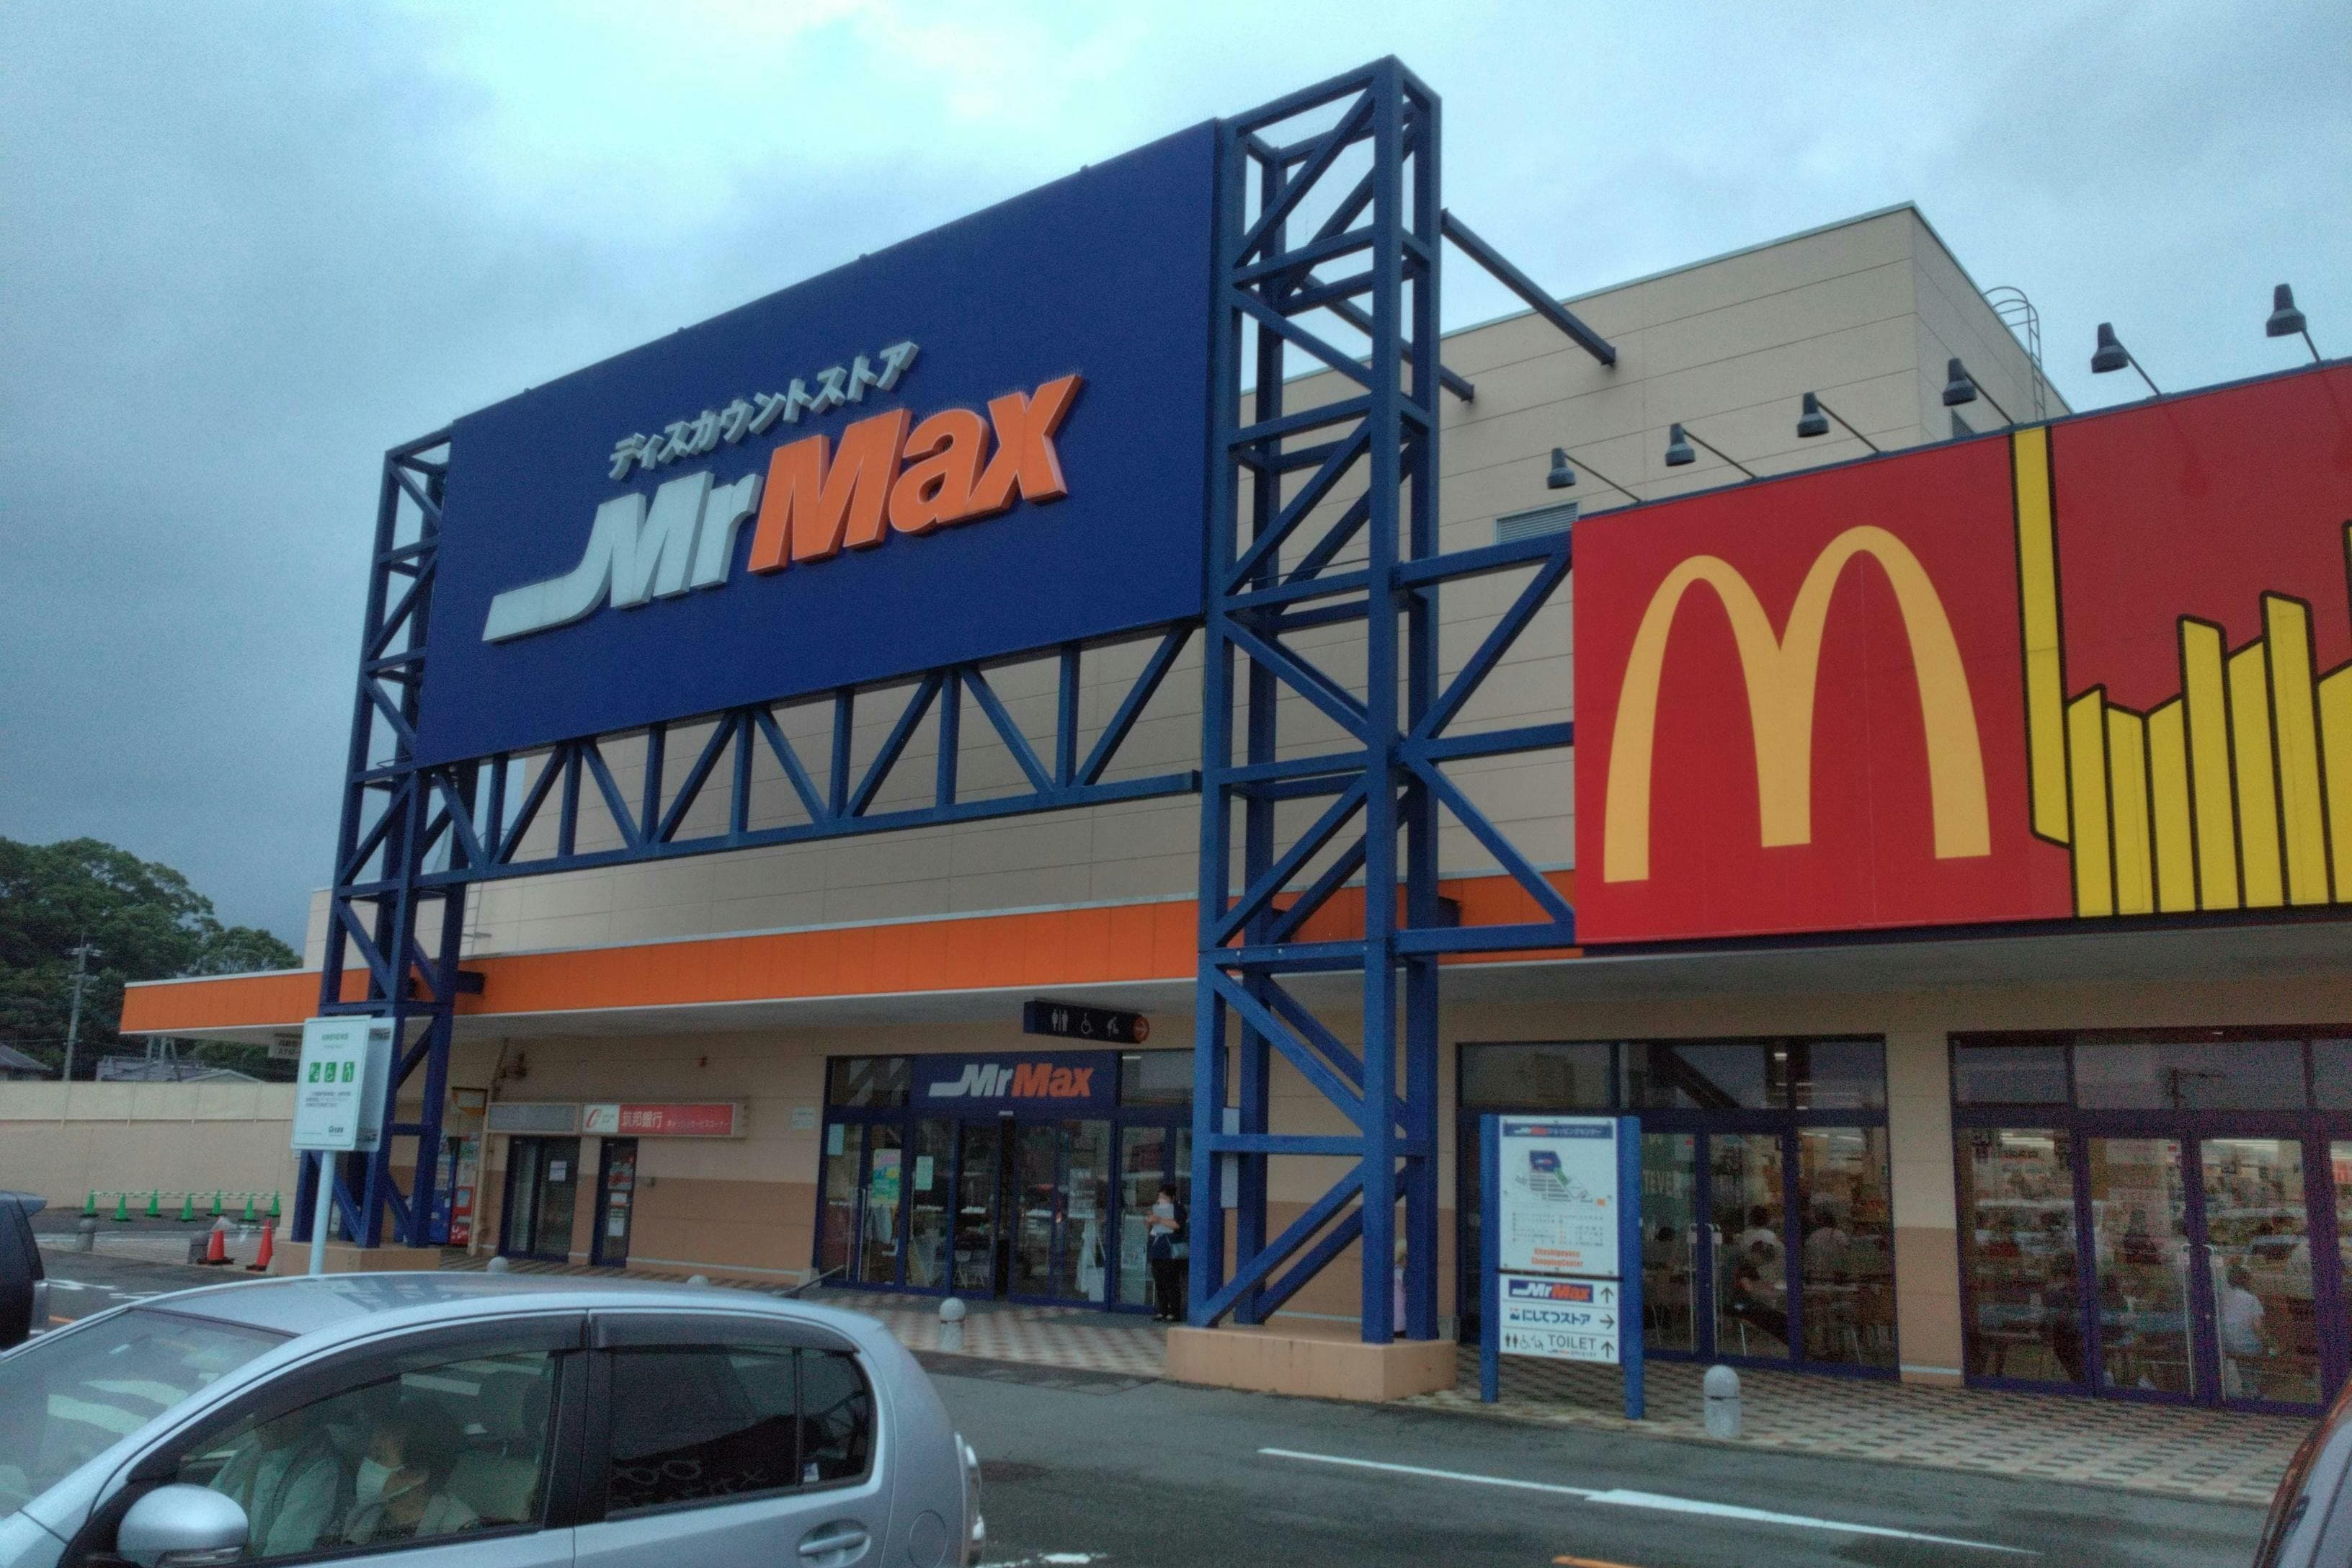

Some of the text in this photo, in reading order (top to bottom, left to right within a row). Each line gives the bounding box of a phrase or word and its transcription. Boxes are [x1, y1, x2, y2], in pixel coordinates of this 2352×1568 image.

[609, 340, 919, 480] ディスカウントストア
[482, 374, 1083, 642] MrMax
[929, 1063, 1094, 1097] MrMax
[1512, 1283, 1590, 1301] MrMax
[1522, 1309, 1591, 1325] にしてつストア
[1548, 1335, 1596, 1350] TOILET
